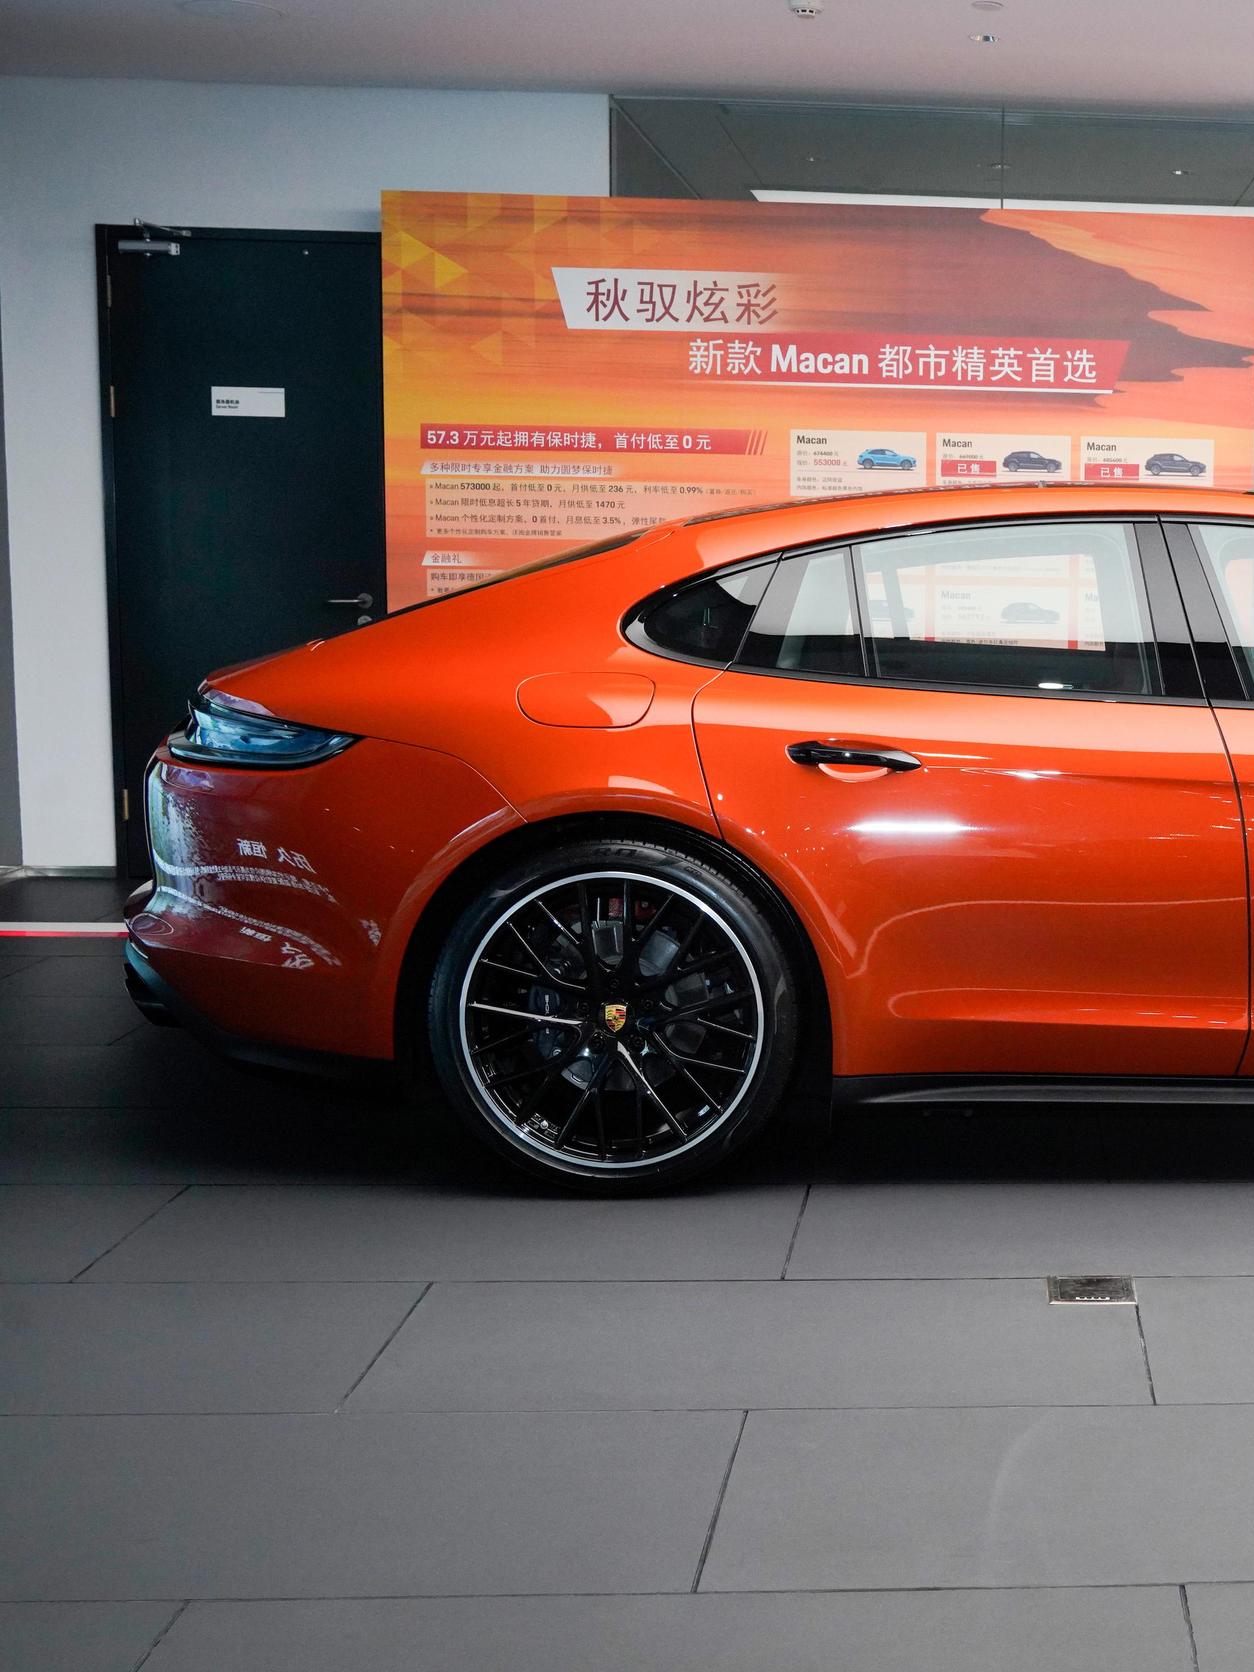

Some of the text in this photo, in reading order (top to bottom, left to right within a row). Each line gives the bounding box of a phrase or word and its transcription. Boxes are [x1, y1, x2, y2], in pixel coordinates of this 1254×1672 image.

[585, 276, 779, 326] 秋驭炫彩
[688, 337, 1099, 384] 新款 Macan 都市精英首选
[427, 431, 460, 444] 57.3
[682, 435, 692, 449] 0
[696, 434, 712, 450] 元
[796, 435, 828, 445] Macan
[942, 438, 973, 448] Macan
[1086, 442, 1117, 452] Macan
[430, 462, 613, 476] 多种限时专享金融方案 助力圆梦保时捷
[435, 482, 459, 491] Macan
[460, 482, 491, 491] 573000
[608, 485, 624, 493] 236
[679, 486, 704, 494] 0.99%
[435, 498, 459, 506] Macan
[595, 501, 616, 509] 1470
[616, 501, 626, 509] 元
[435, 514, 460, 522] Macan
[532, 515, 538, 523] 0
[431, 553, 462, 564] 金融礼
